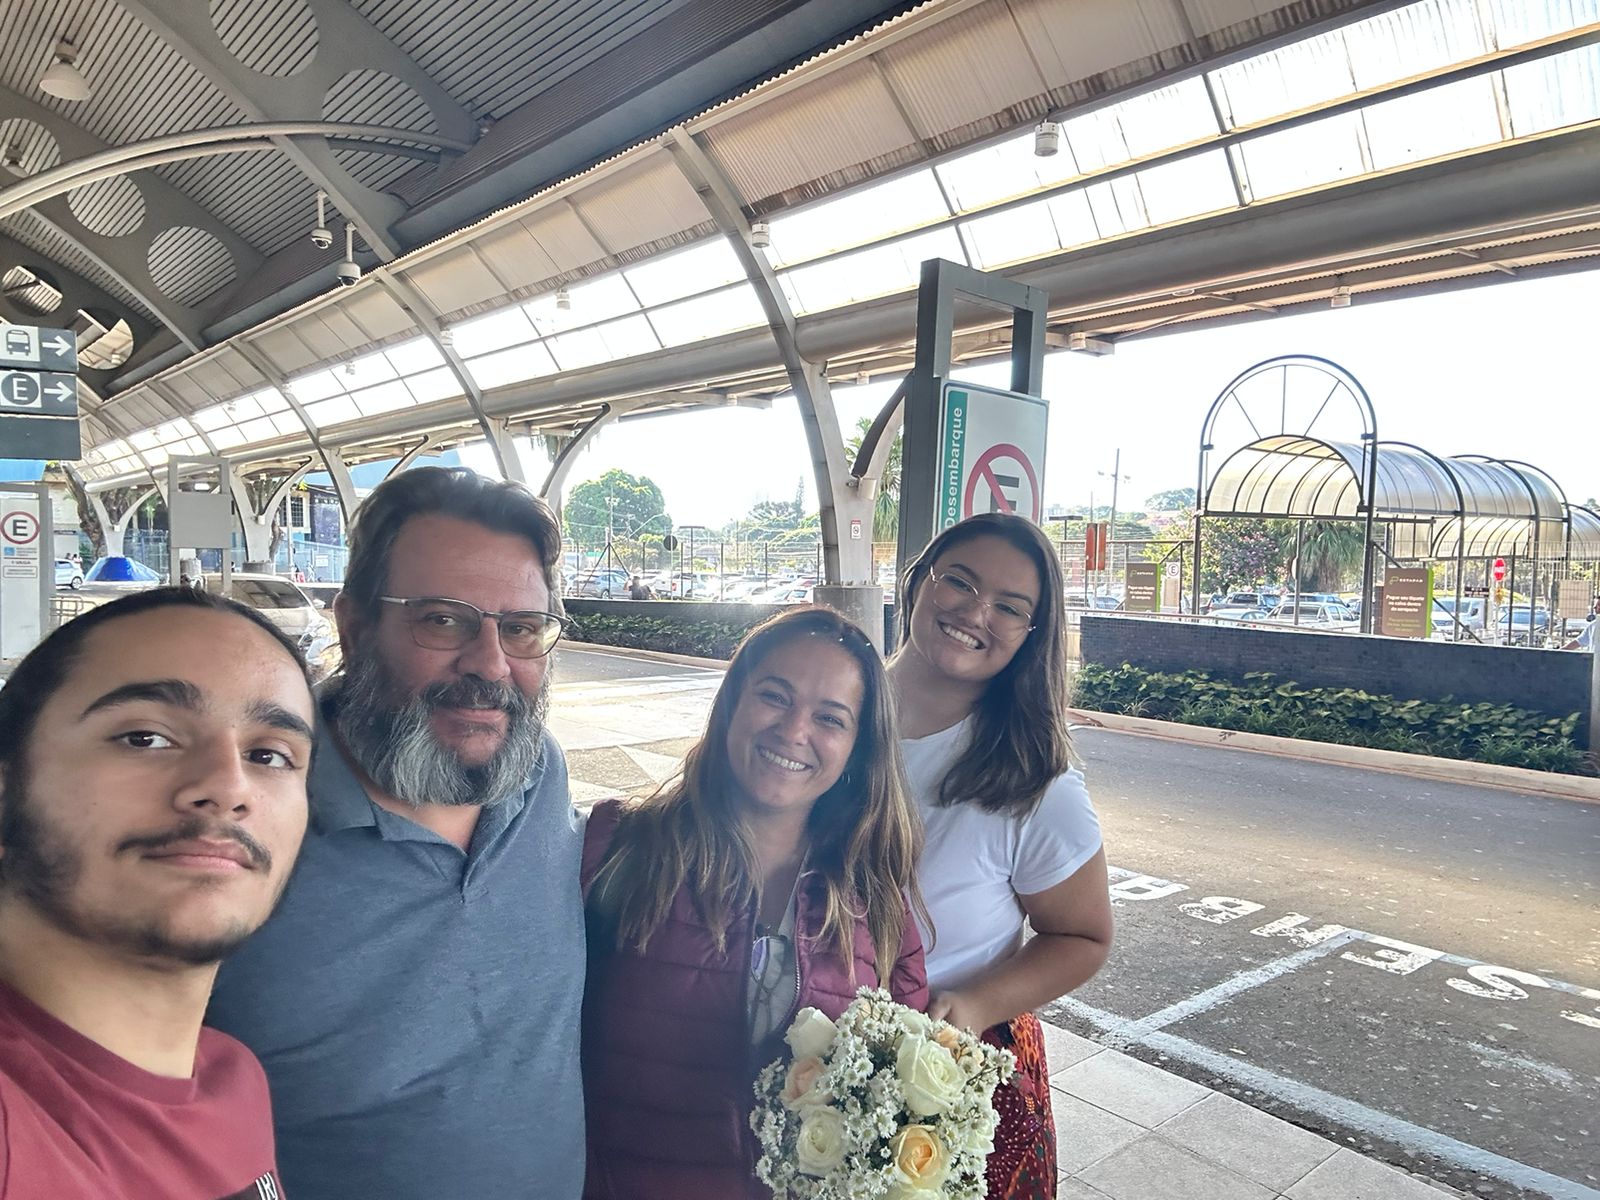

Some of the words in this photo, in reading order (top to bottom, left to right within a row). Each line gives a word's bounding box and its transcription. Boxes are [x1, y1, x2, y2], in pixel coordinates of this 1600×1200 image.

[12, 377, 29, 401] E
[944, 407, 964, 528] Desembarque
[12, 519, 28, 537] E
